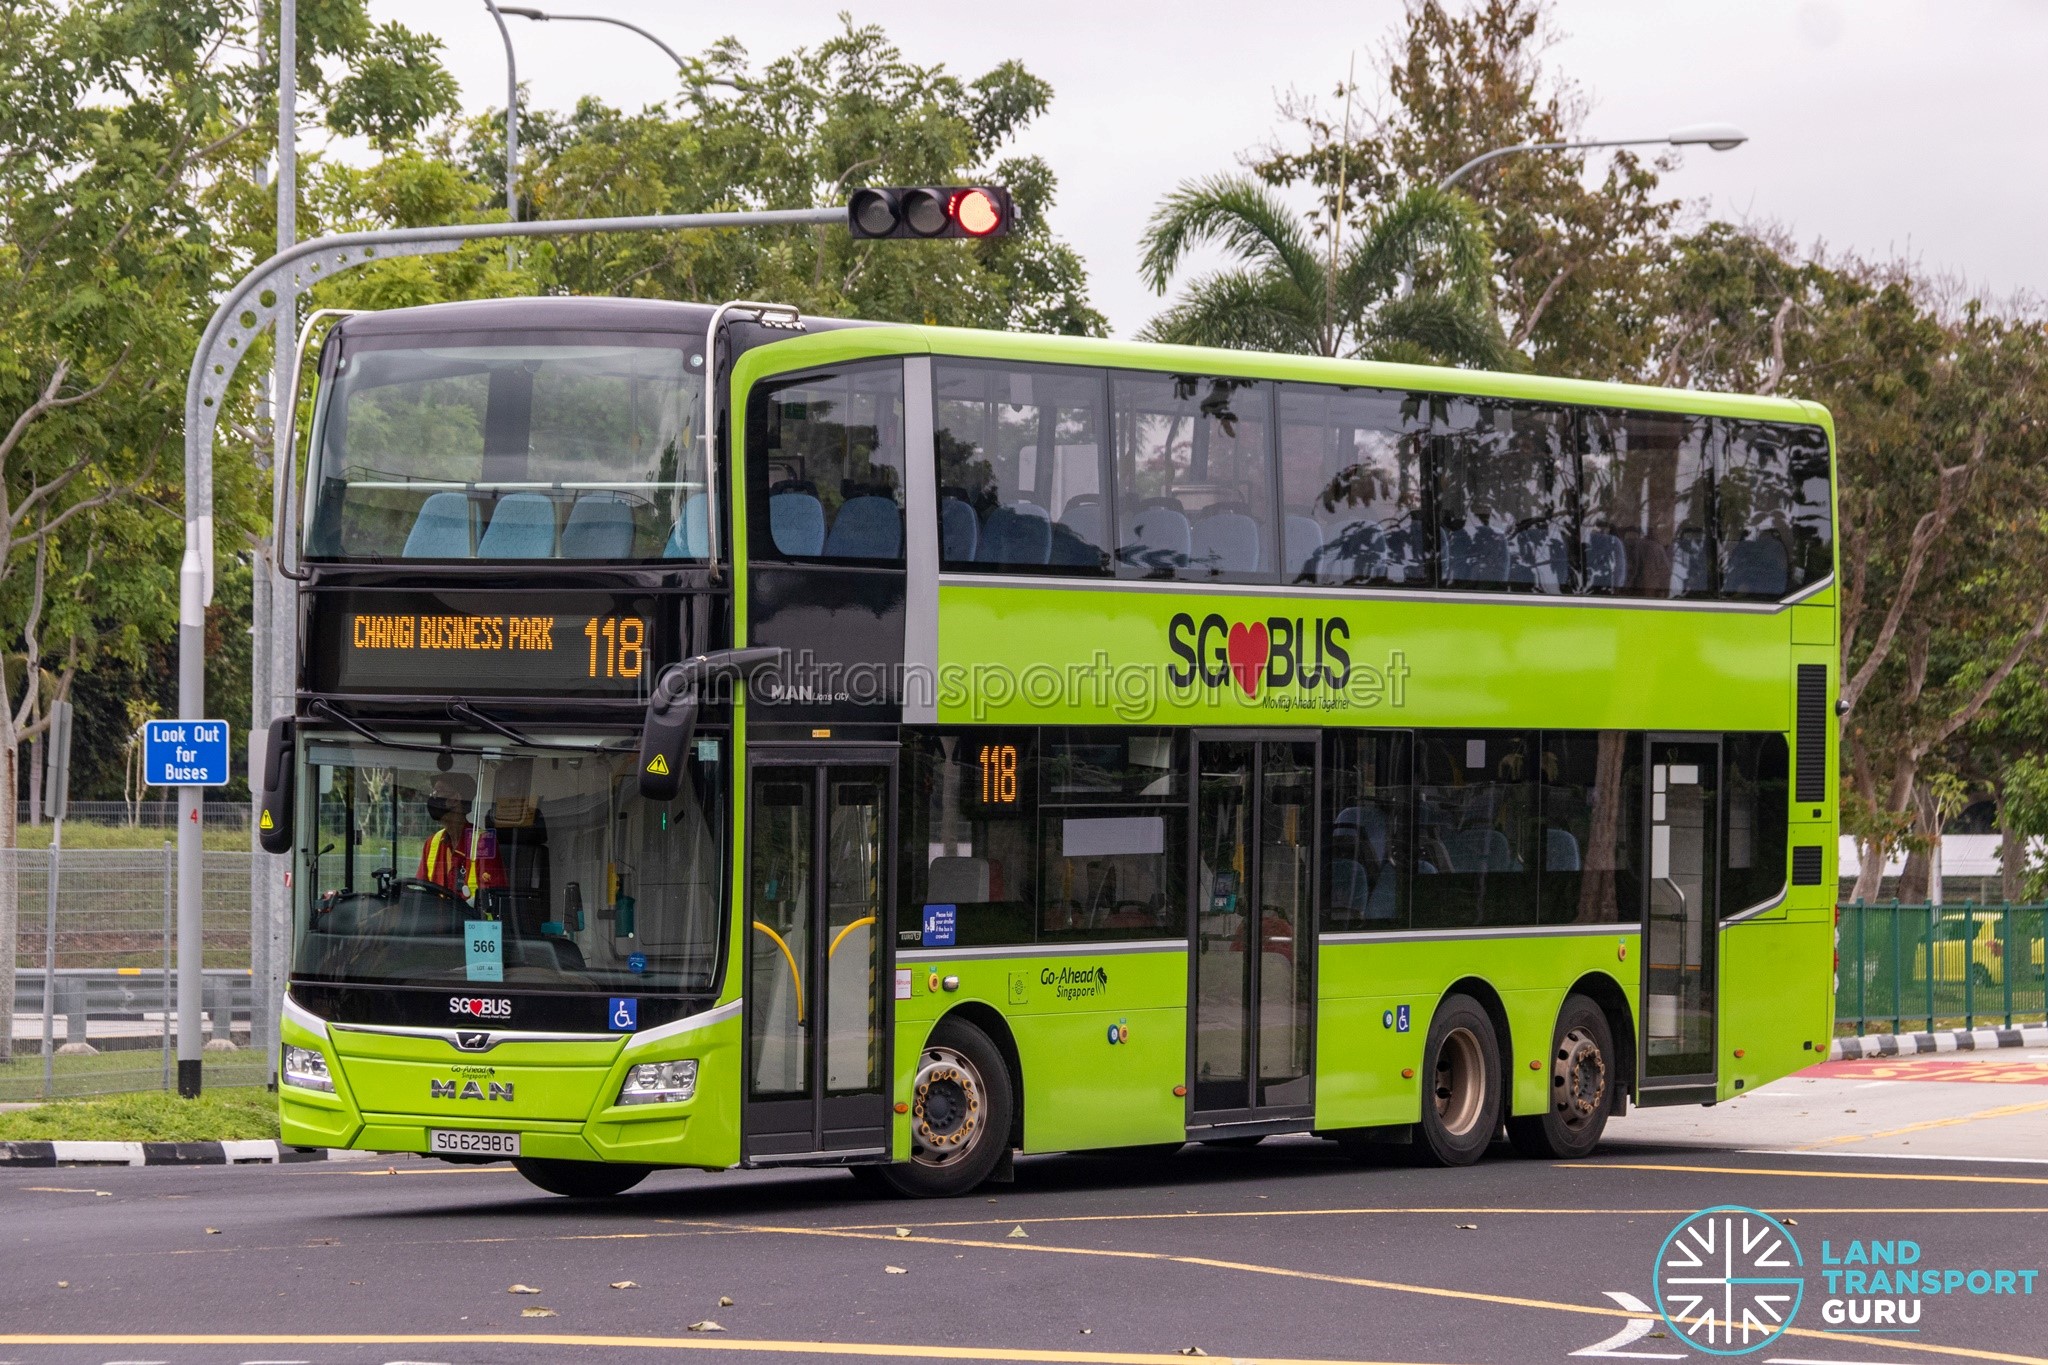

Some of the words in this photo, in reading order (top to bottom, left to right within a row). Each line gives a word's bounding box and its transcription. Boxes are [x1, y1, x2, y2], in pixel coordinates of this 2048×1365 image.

[353, 615, 415, 648] CHANGI
[419, 616, 503, 650] BUSINESS
[508, 617, 553, 650] PARK
[584, 617, 644, 677] 118
[771, 684, 813, 700] MAN
[1262, 695, 1291, 712] Moving
[1292, 695, 1316, 710] Ahead
[1318, 696, 1349, 712] Together
[153, 725, 186, 743] Look
[193, 725, 220, 743] Out
[175, 745, 197, 762] for
[164, 763, 208, 780] Buses
[979, 745, 1017, 803] 118
[190, 808, 198, 824] 4
[473, 940, 495, 953] 566
[1040, 966, 1094, 985] Go-Ahead
[1057, 985, 1095, 1001] Singapore
[431, 1078, 514, 1102] MAN
[437, 1132, 514, 1152] SG6298G
